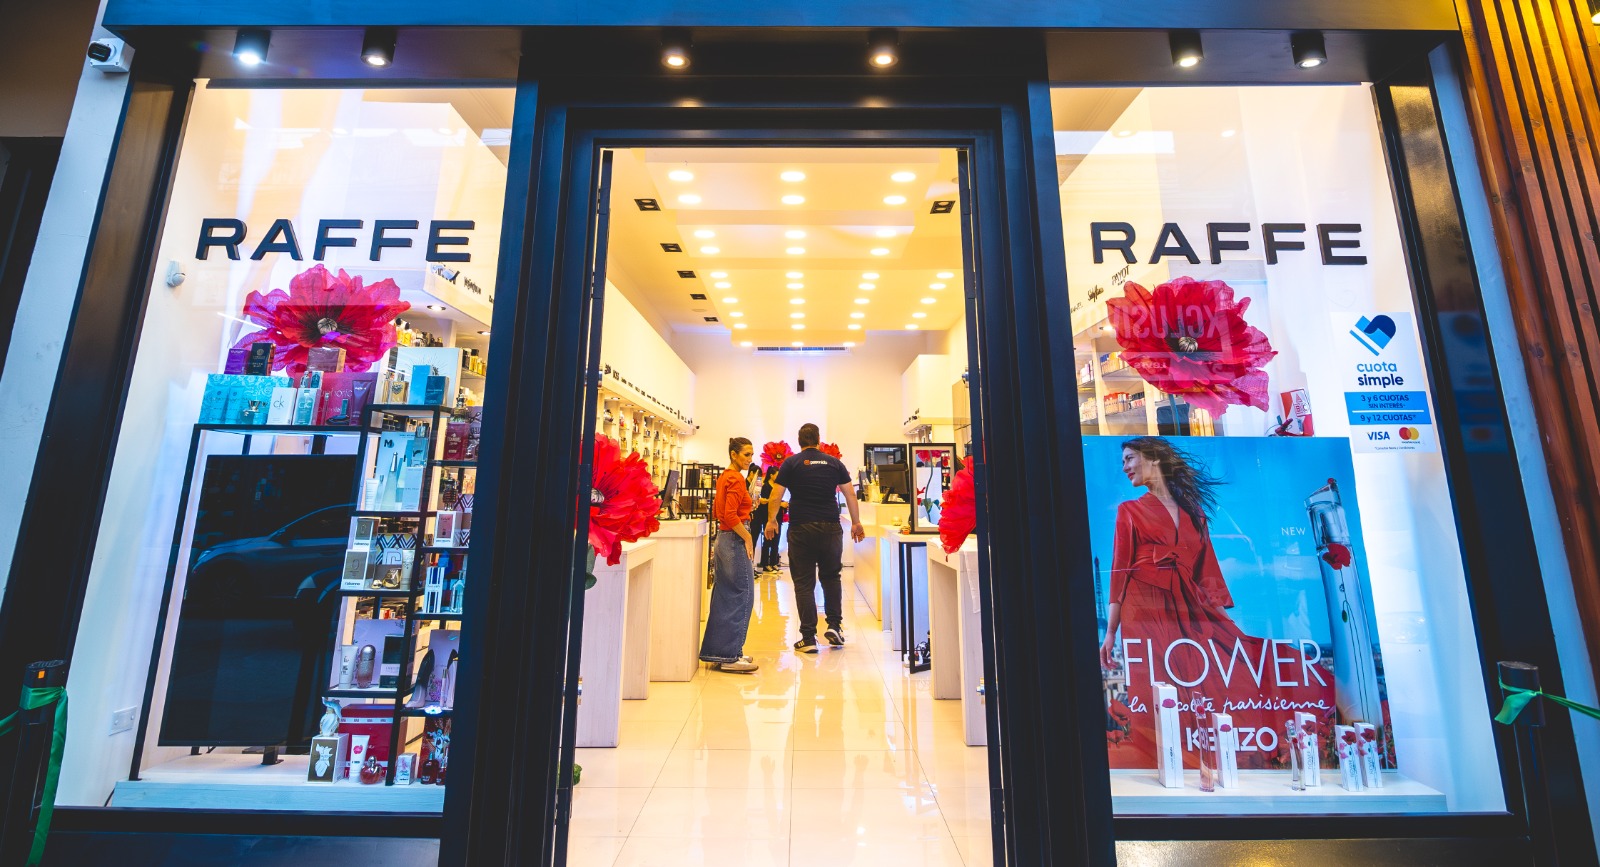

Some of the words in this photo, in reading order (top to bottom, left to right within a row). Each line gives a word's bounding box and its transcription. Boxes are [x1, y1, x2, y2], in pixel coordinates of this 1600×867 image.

[195, 218, 475, 262] RAFFE
[1090, 221, 1368, 266] RAFFE
[1357, 362, 1397, 372] cuota
[1358, 374, 1404, 388] simple
[1367, 431, 1390, 440] VISA
[1281, 526, 1306, 536] NEW
[1123, 637, 1327, 688] FLOWER
[1129, 695, 1148, 713] la
[1223, 694, 1330, 714] parisienne
